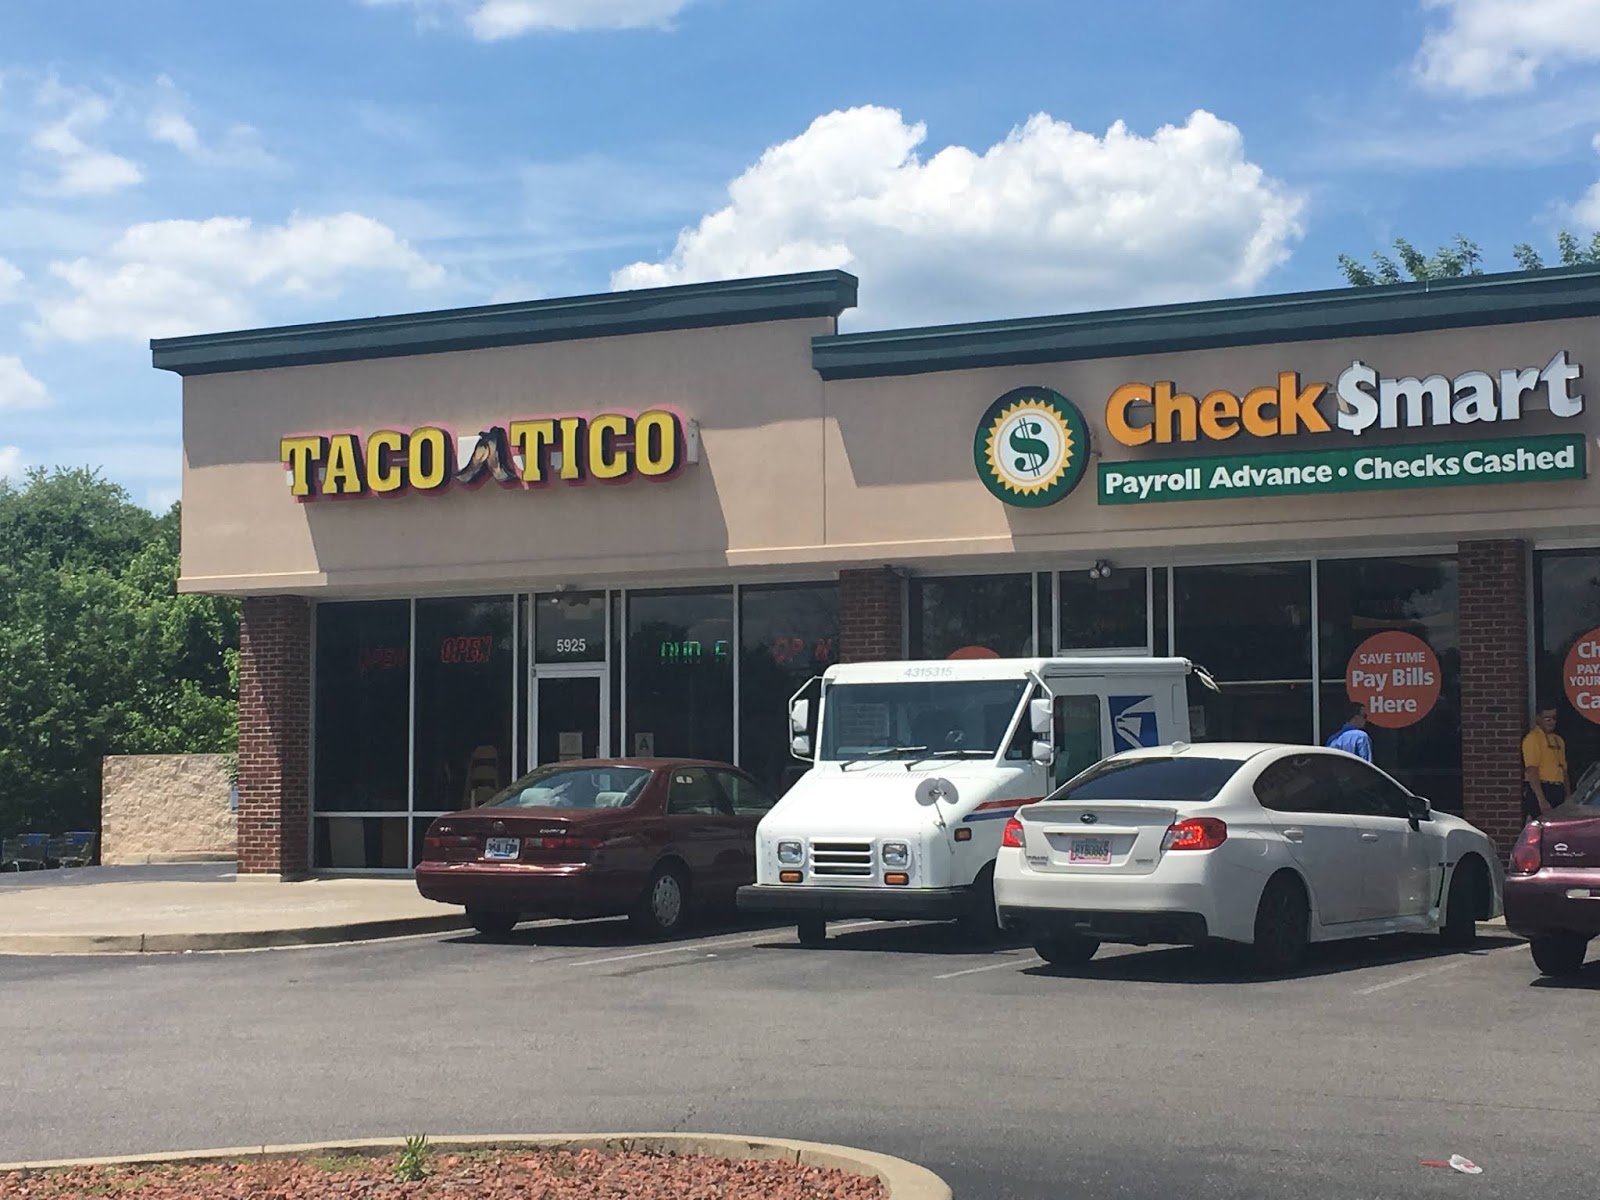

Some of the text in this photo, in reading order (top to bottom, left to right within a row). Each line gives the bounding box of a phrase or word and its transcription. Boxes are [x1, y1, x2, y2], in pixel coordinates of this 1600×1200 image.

[281, 409, 677, 496] TACO TICO
[1106, 445, 1575, 499] Payroll Advance Checks Cashed
[556, 638, 587, 652] 5925
[1360, 651, 1426, 665] SAVE TIME
[903, 667, 953, 678] 4315315
[1352, 667, 1435, 692] Pay Bills
[1370, 696, 1417, 713] Here
